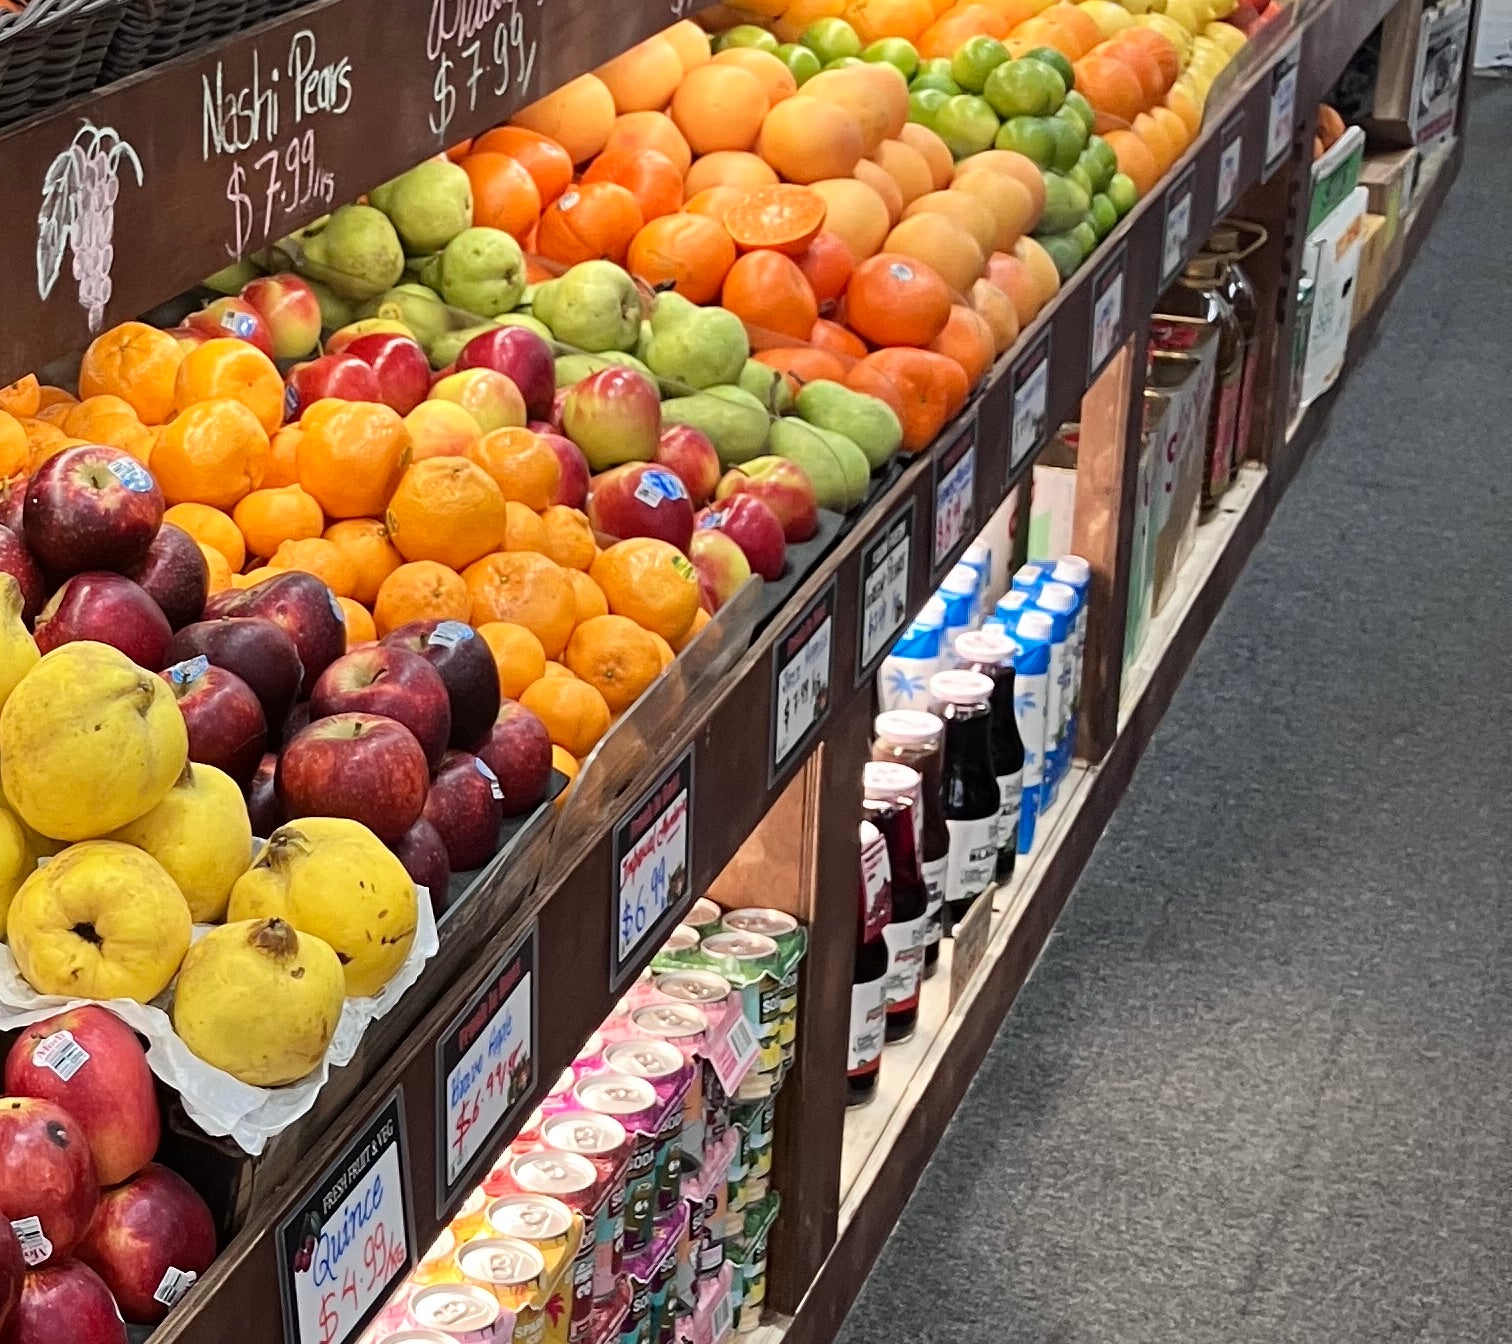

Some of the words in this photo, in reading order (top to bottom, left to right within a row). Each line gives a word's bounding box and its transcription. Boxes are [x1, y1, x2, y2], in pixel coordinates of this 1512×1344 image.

[201, 48, 279, 161] Nashi
[288, 30, 352, 123] Pears
[313, 1172, 385, 1287] Quince
